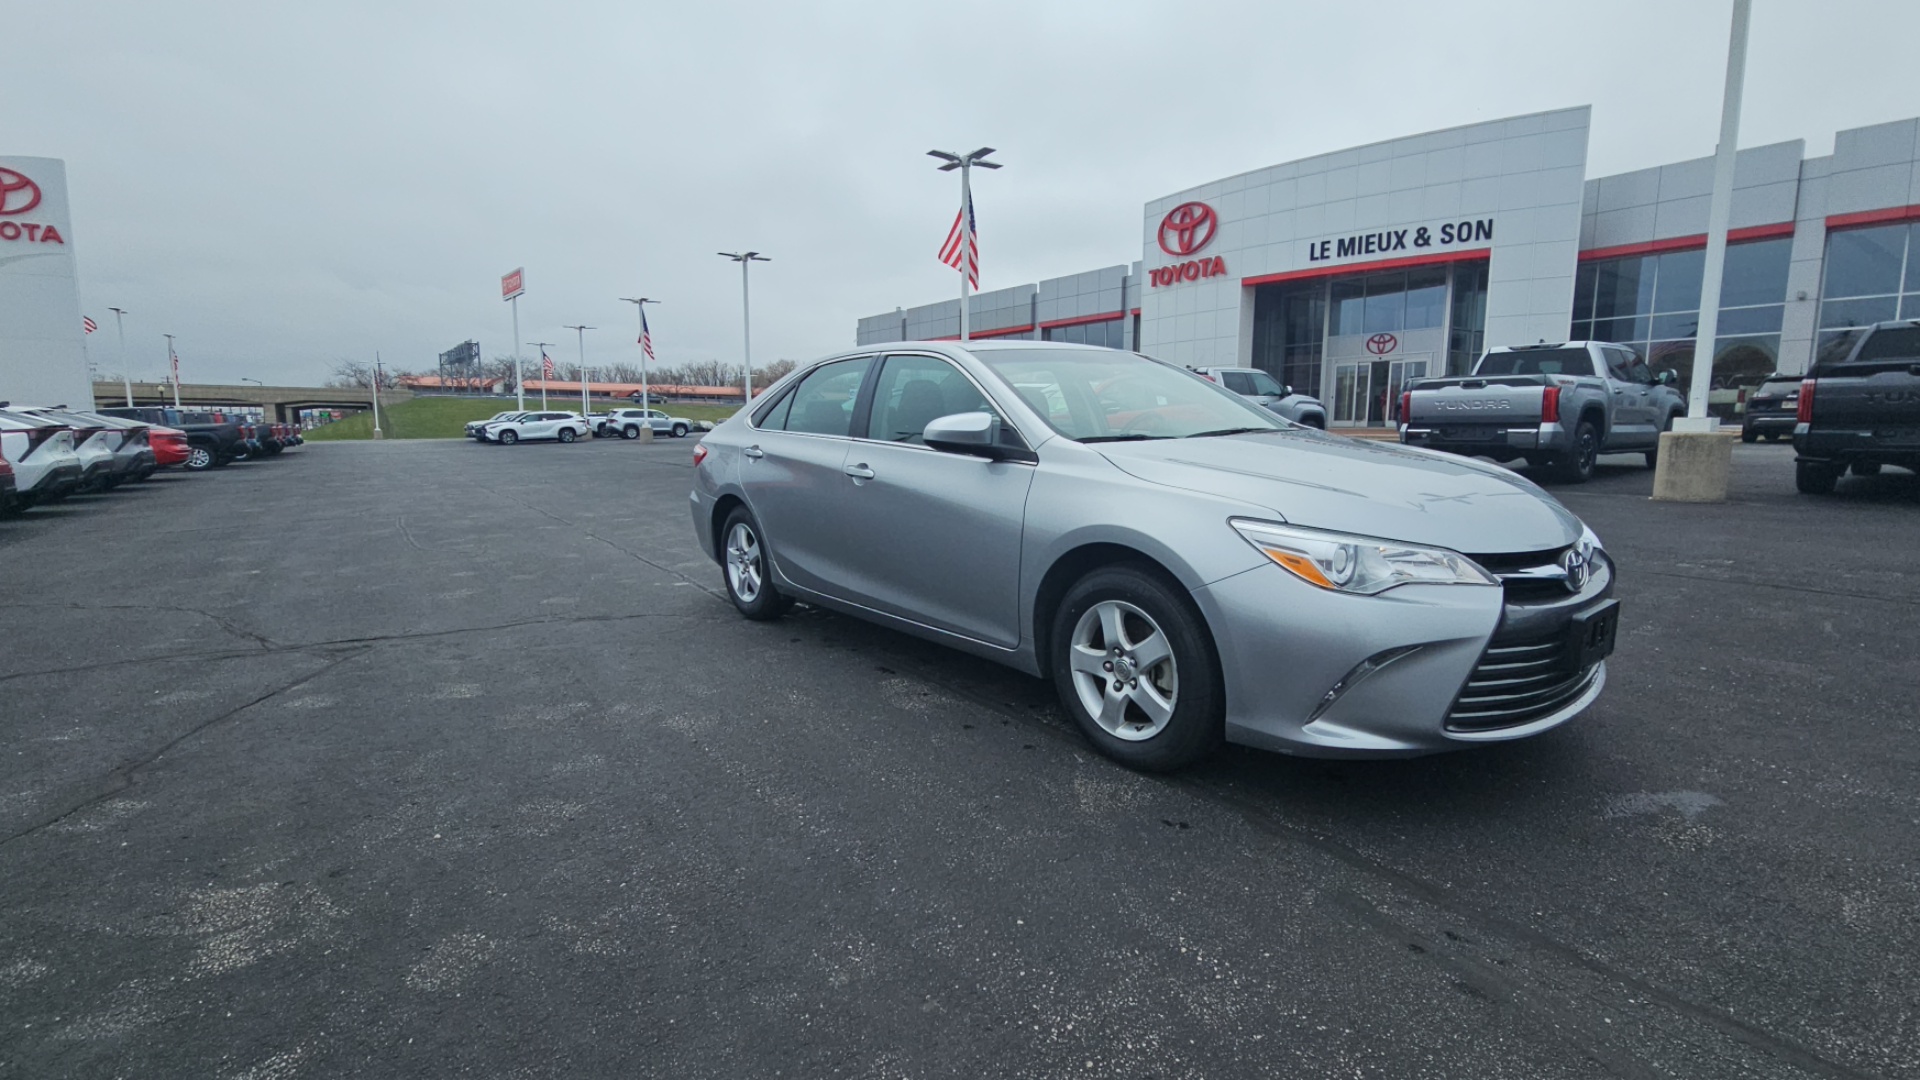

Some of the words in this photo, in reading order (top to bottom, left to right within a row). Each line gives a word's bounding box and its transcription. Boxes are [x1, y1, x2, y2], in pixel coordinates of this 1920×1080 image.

[1310, 240, 1331, 261] LE
[1336, 229, 1408, 258] MIEUX
[1413, 226, 1431, 248] &
[1440, 218, 1494, 245] SON
[1148, 255, 1227, 288] TOYOTA
[1434, 399, 1511, 410] TUNDRA
